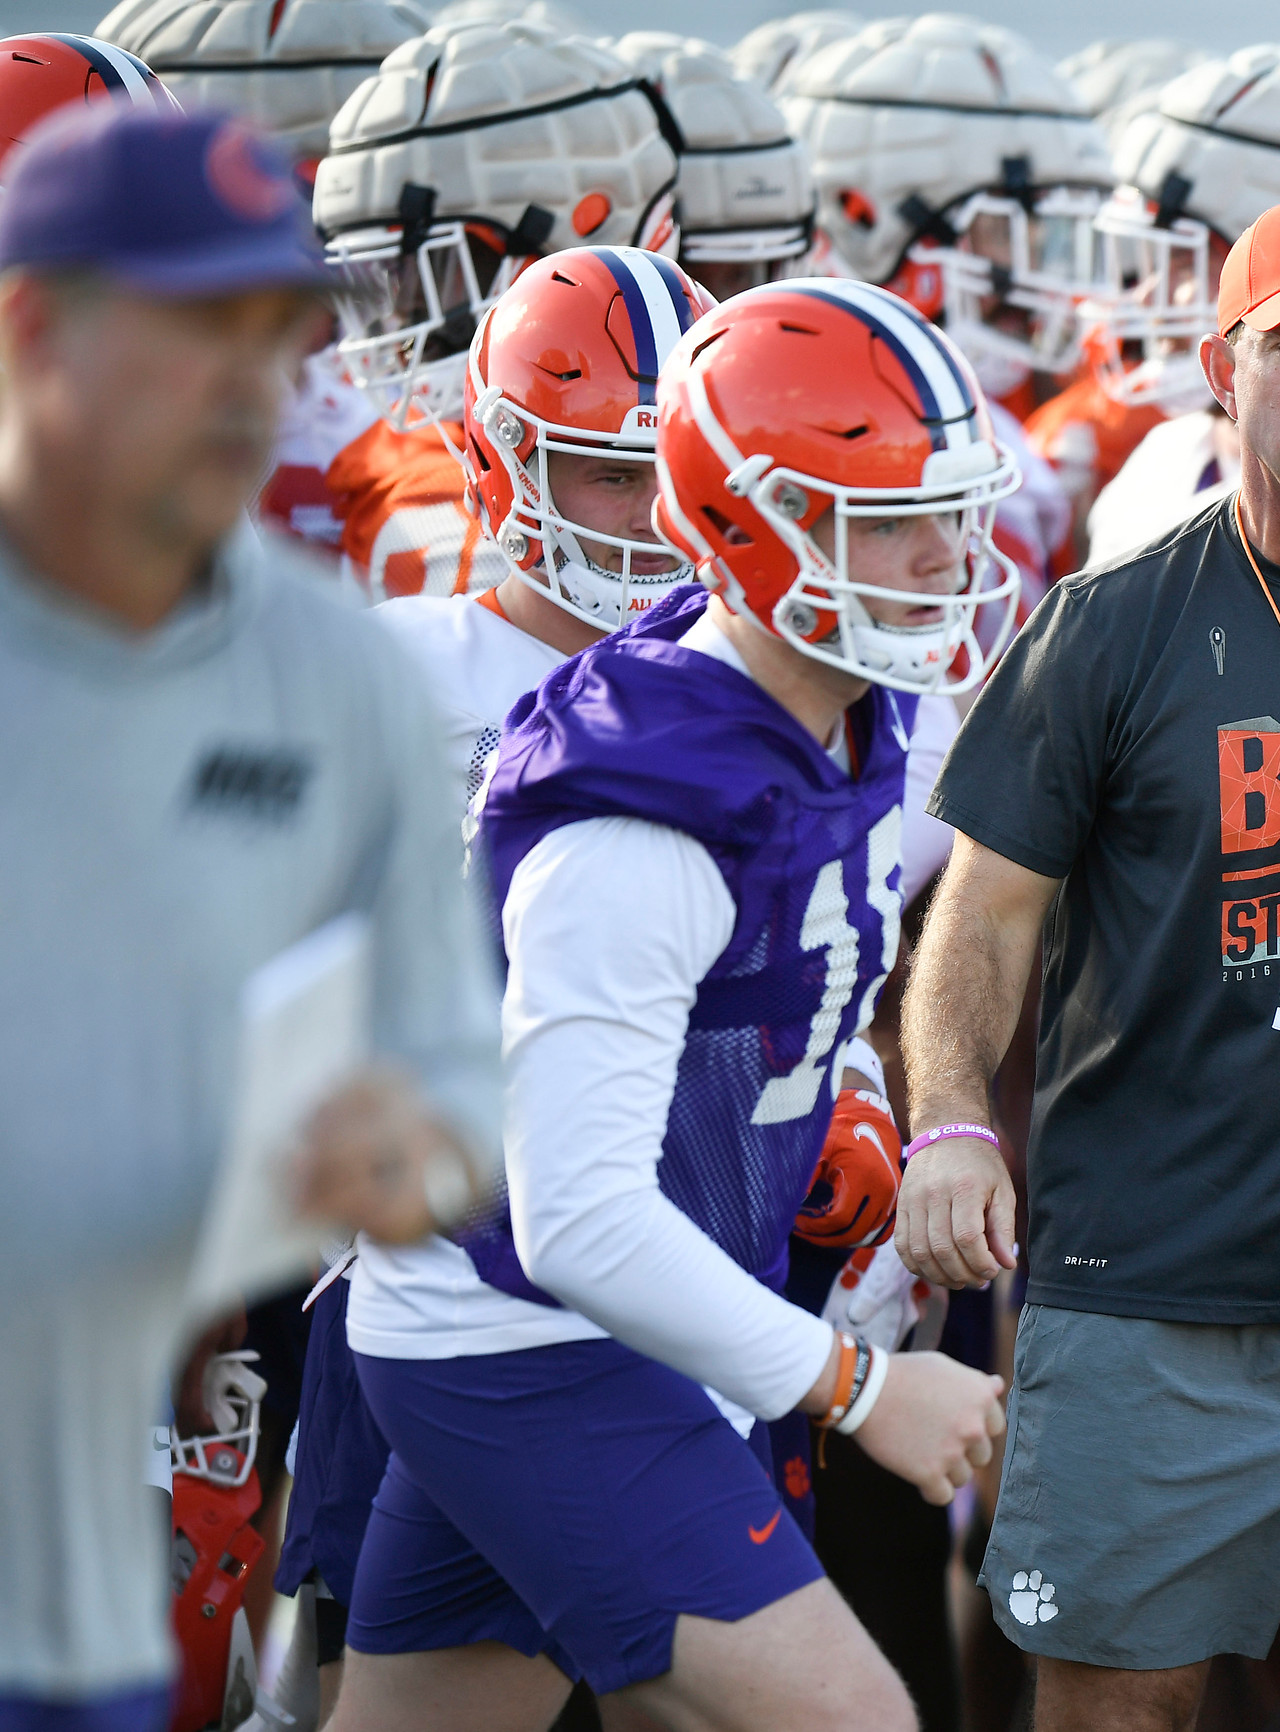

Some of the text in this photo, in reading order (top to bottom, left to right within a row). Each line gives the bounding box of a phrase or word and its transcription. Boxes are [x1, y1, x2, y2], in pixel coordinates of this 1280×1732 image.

[1222, 965, 1271, 982] 2016
[942, 1125, 995, 1140] CLEMSON
[1064, 1256, 1108, 1268] DRI-FIT
